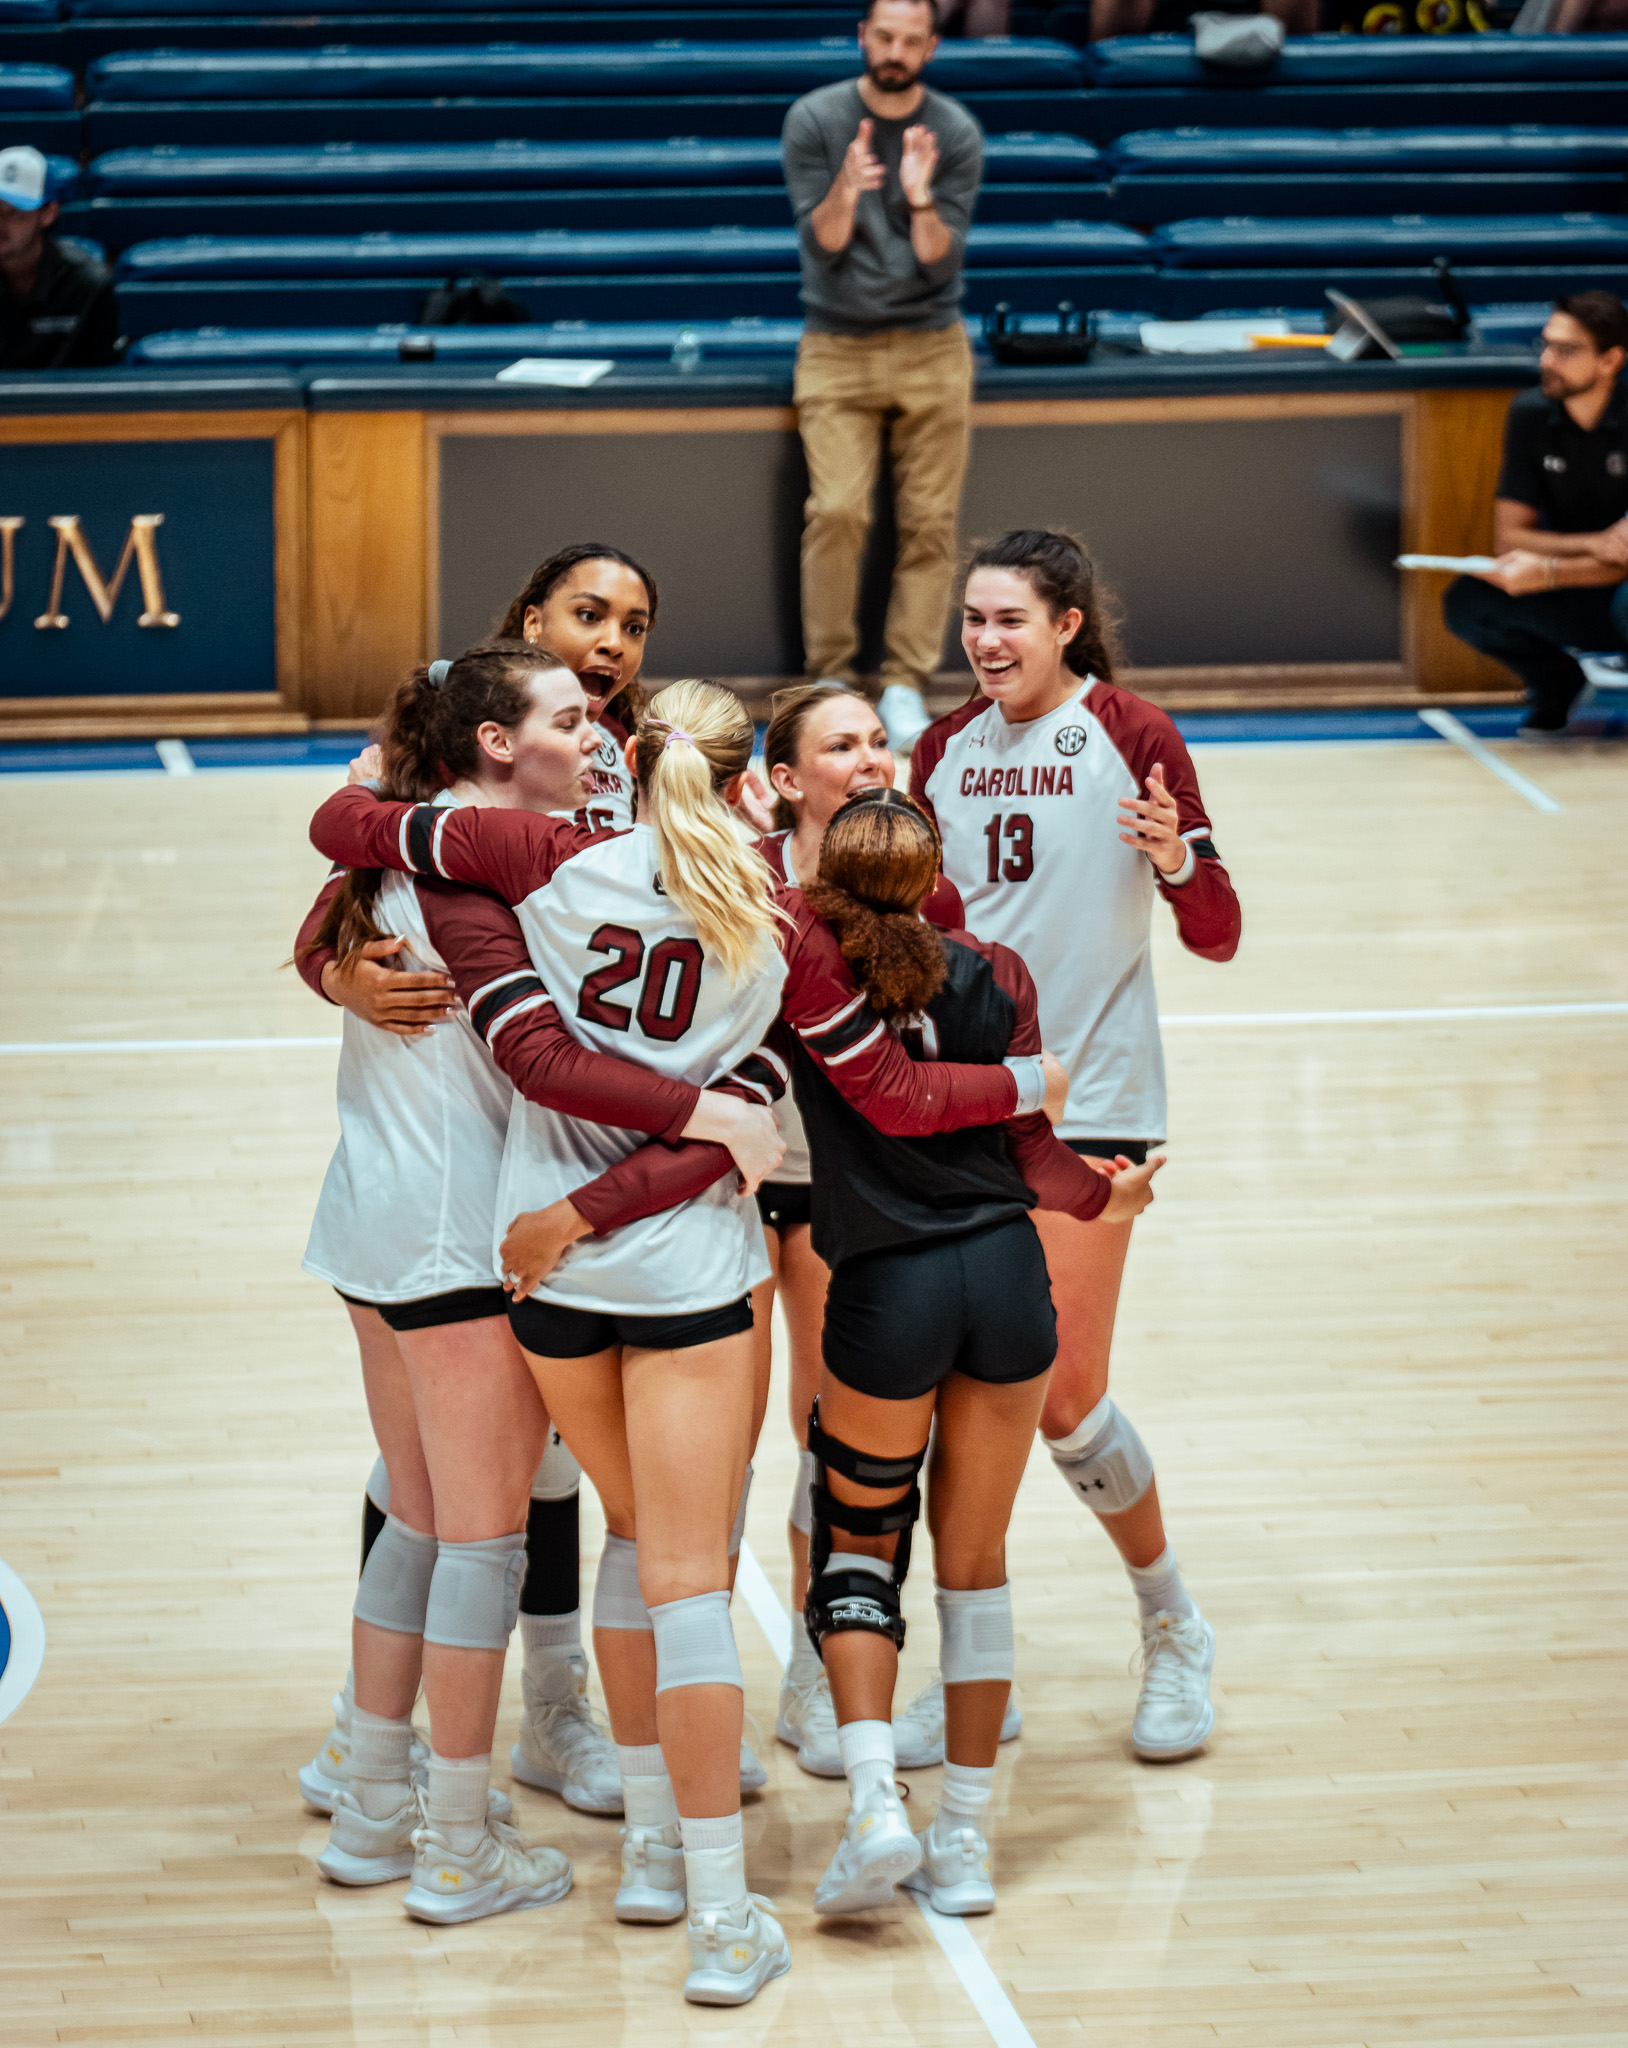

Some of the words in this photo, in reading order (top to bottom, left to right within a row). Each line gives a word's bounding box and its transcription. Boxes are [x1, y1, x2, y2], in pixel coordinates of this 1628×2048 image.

[1055, 726, 1087, 756] SEC
[959, 765, 1074, 797] CAROLINA
[983, 812, 1034, 883] 13
[576, 922, 704, 1042] 20
